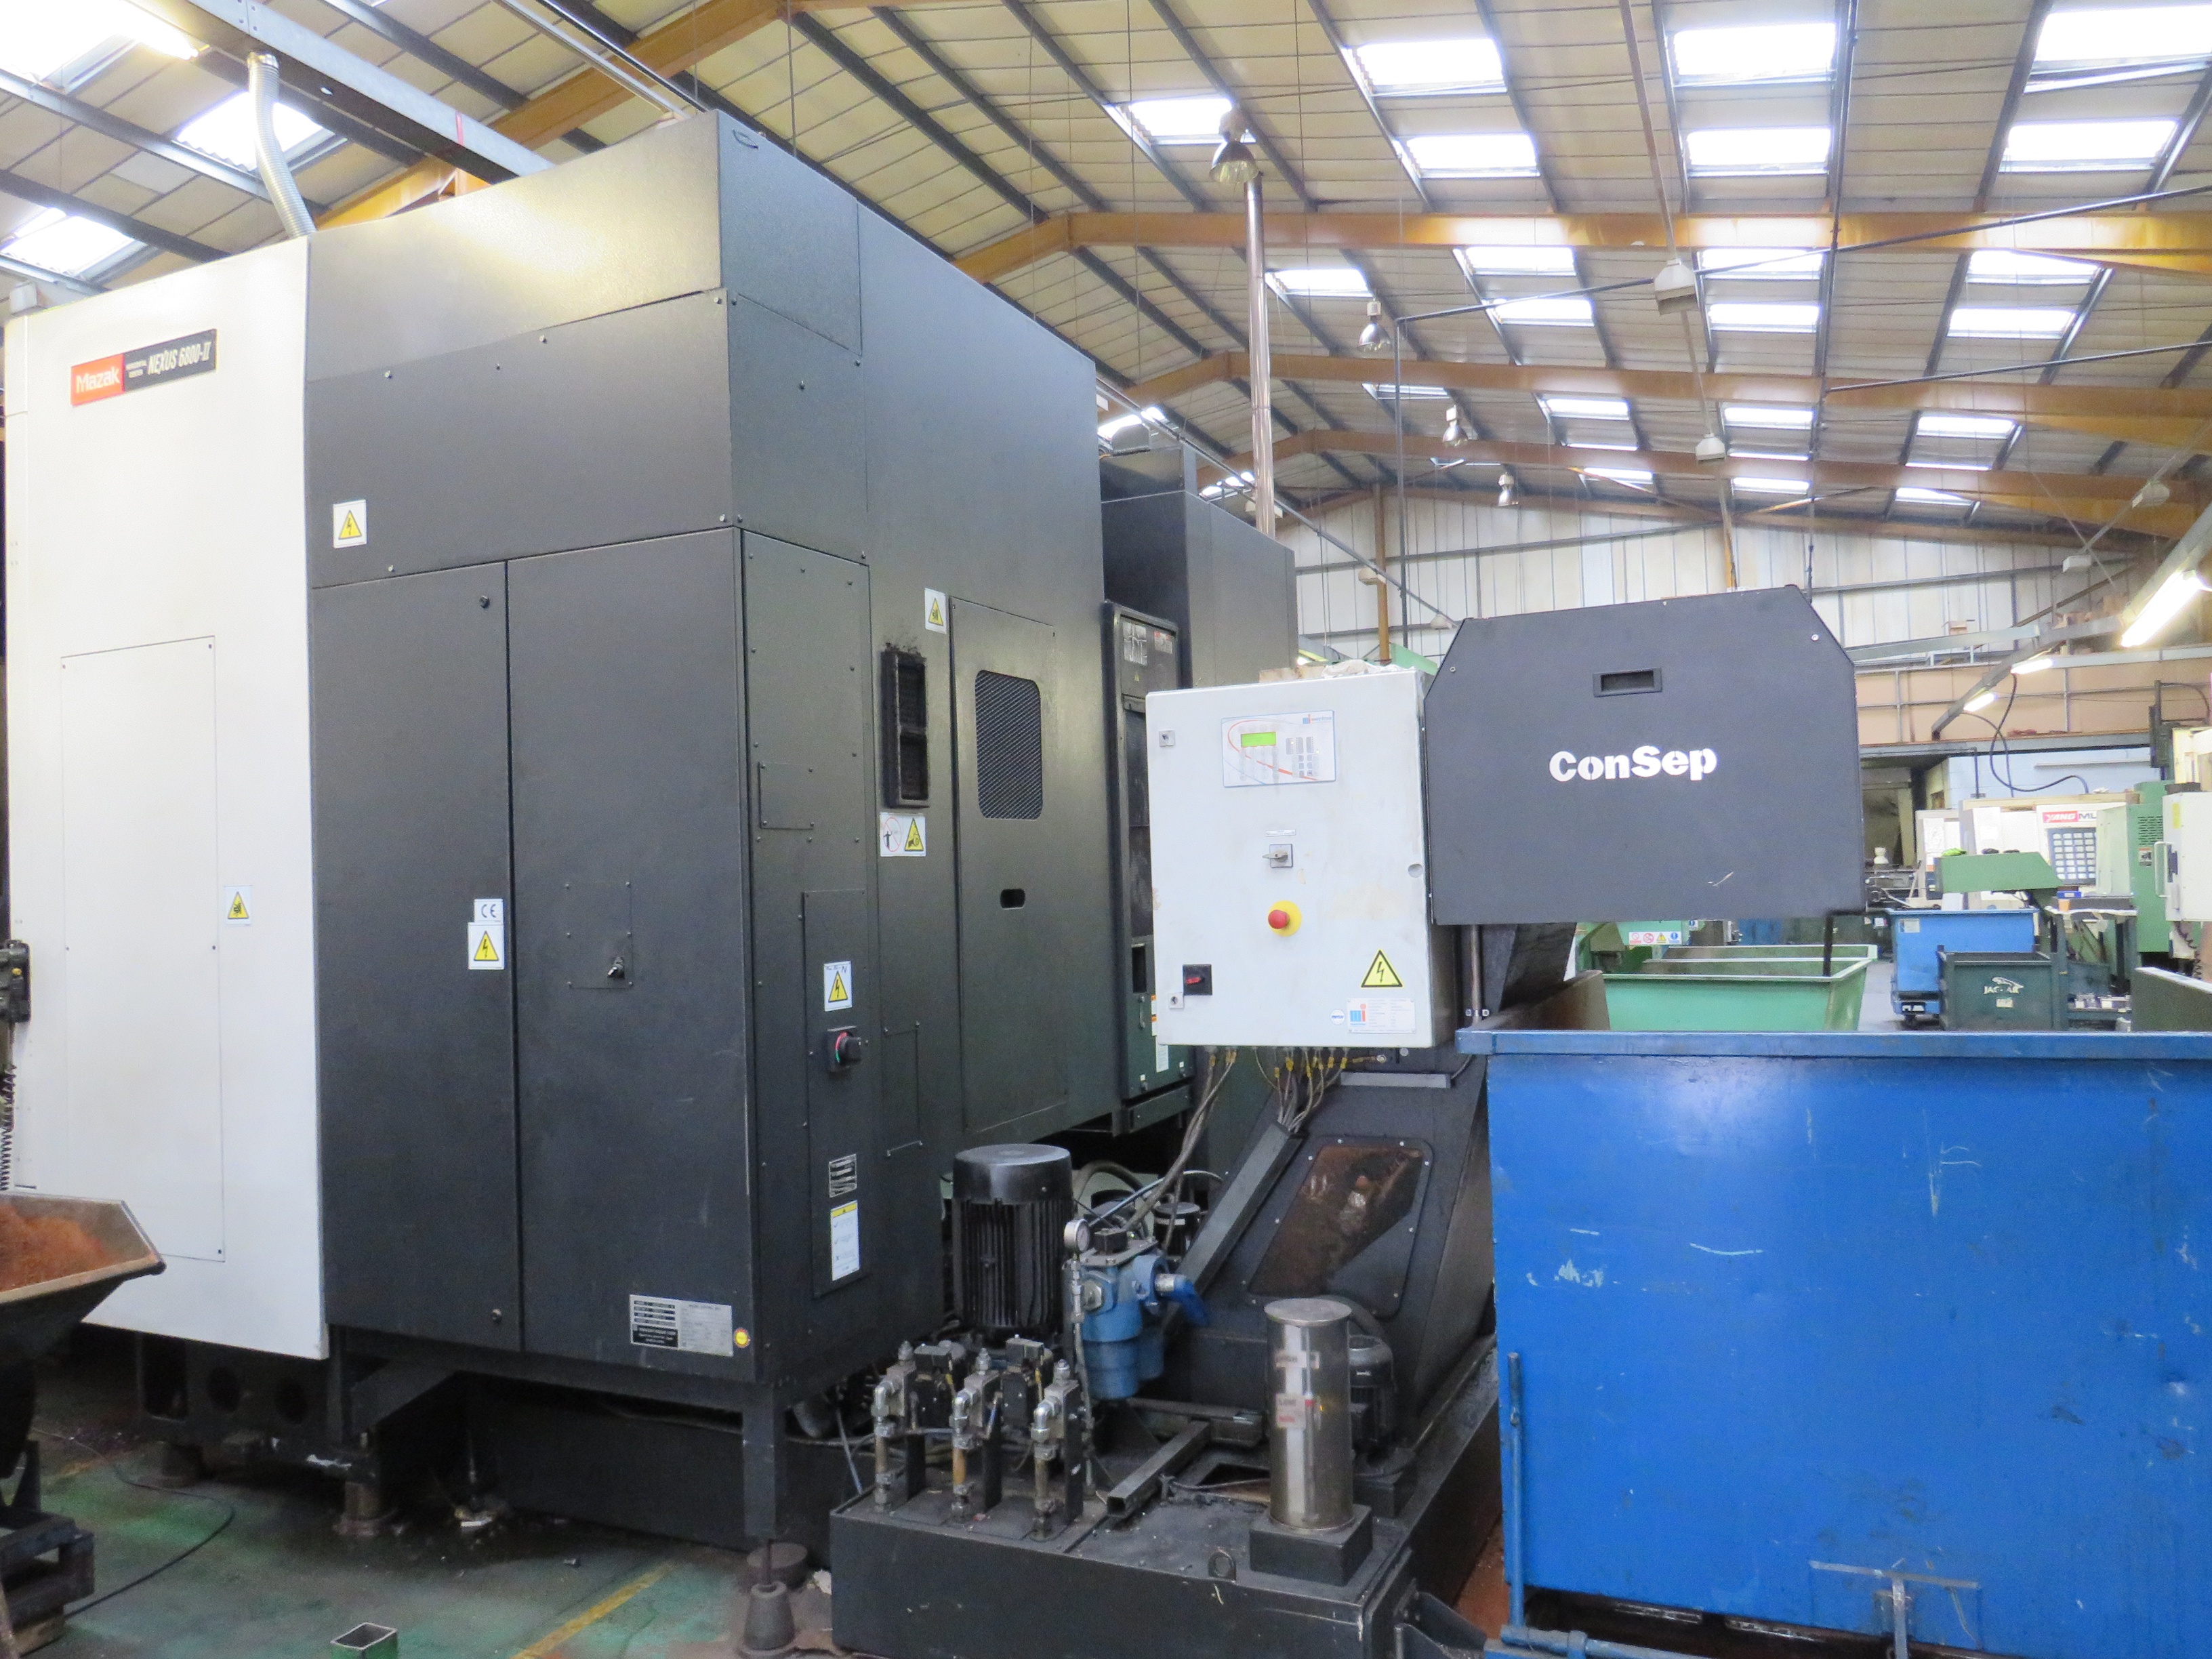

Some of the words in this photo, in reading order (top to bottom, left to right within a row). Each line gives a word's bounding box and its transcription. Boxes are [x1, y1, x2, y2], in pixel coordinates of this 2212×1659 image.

[147, 349, 178, 375] NEXUS
[75, 365, 121, 394] Mazak
[1549, 745, 1718, 782] ConSep
[2045, 813, 2076, 823] YANG
